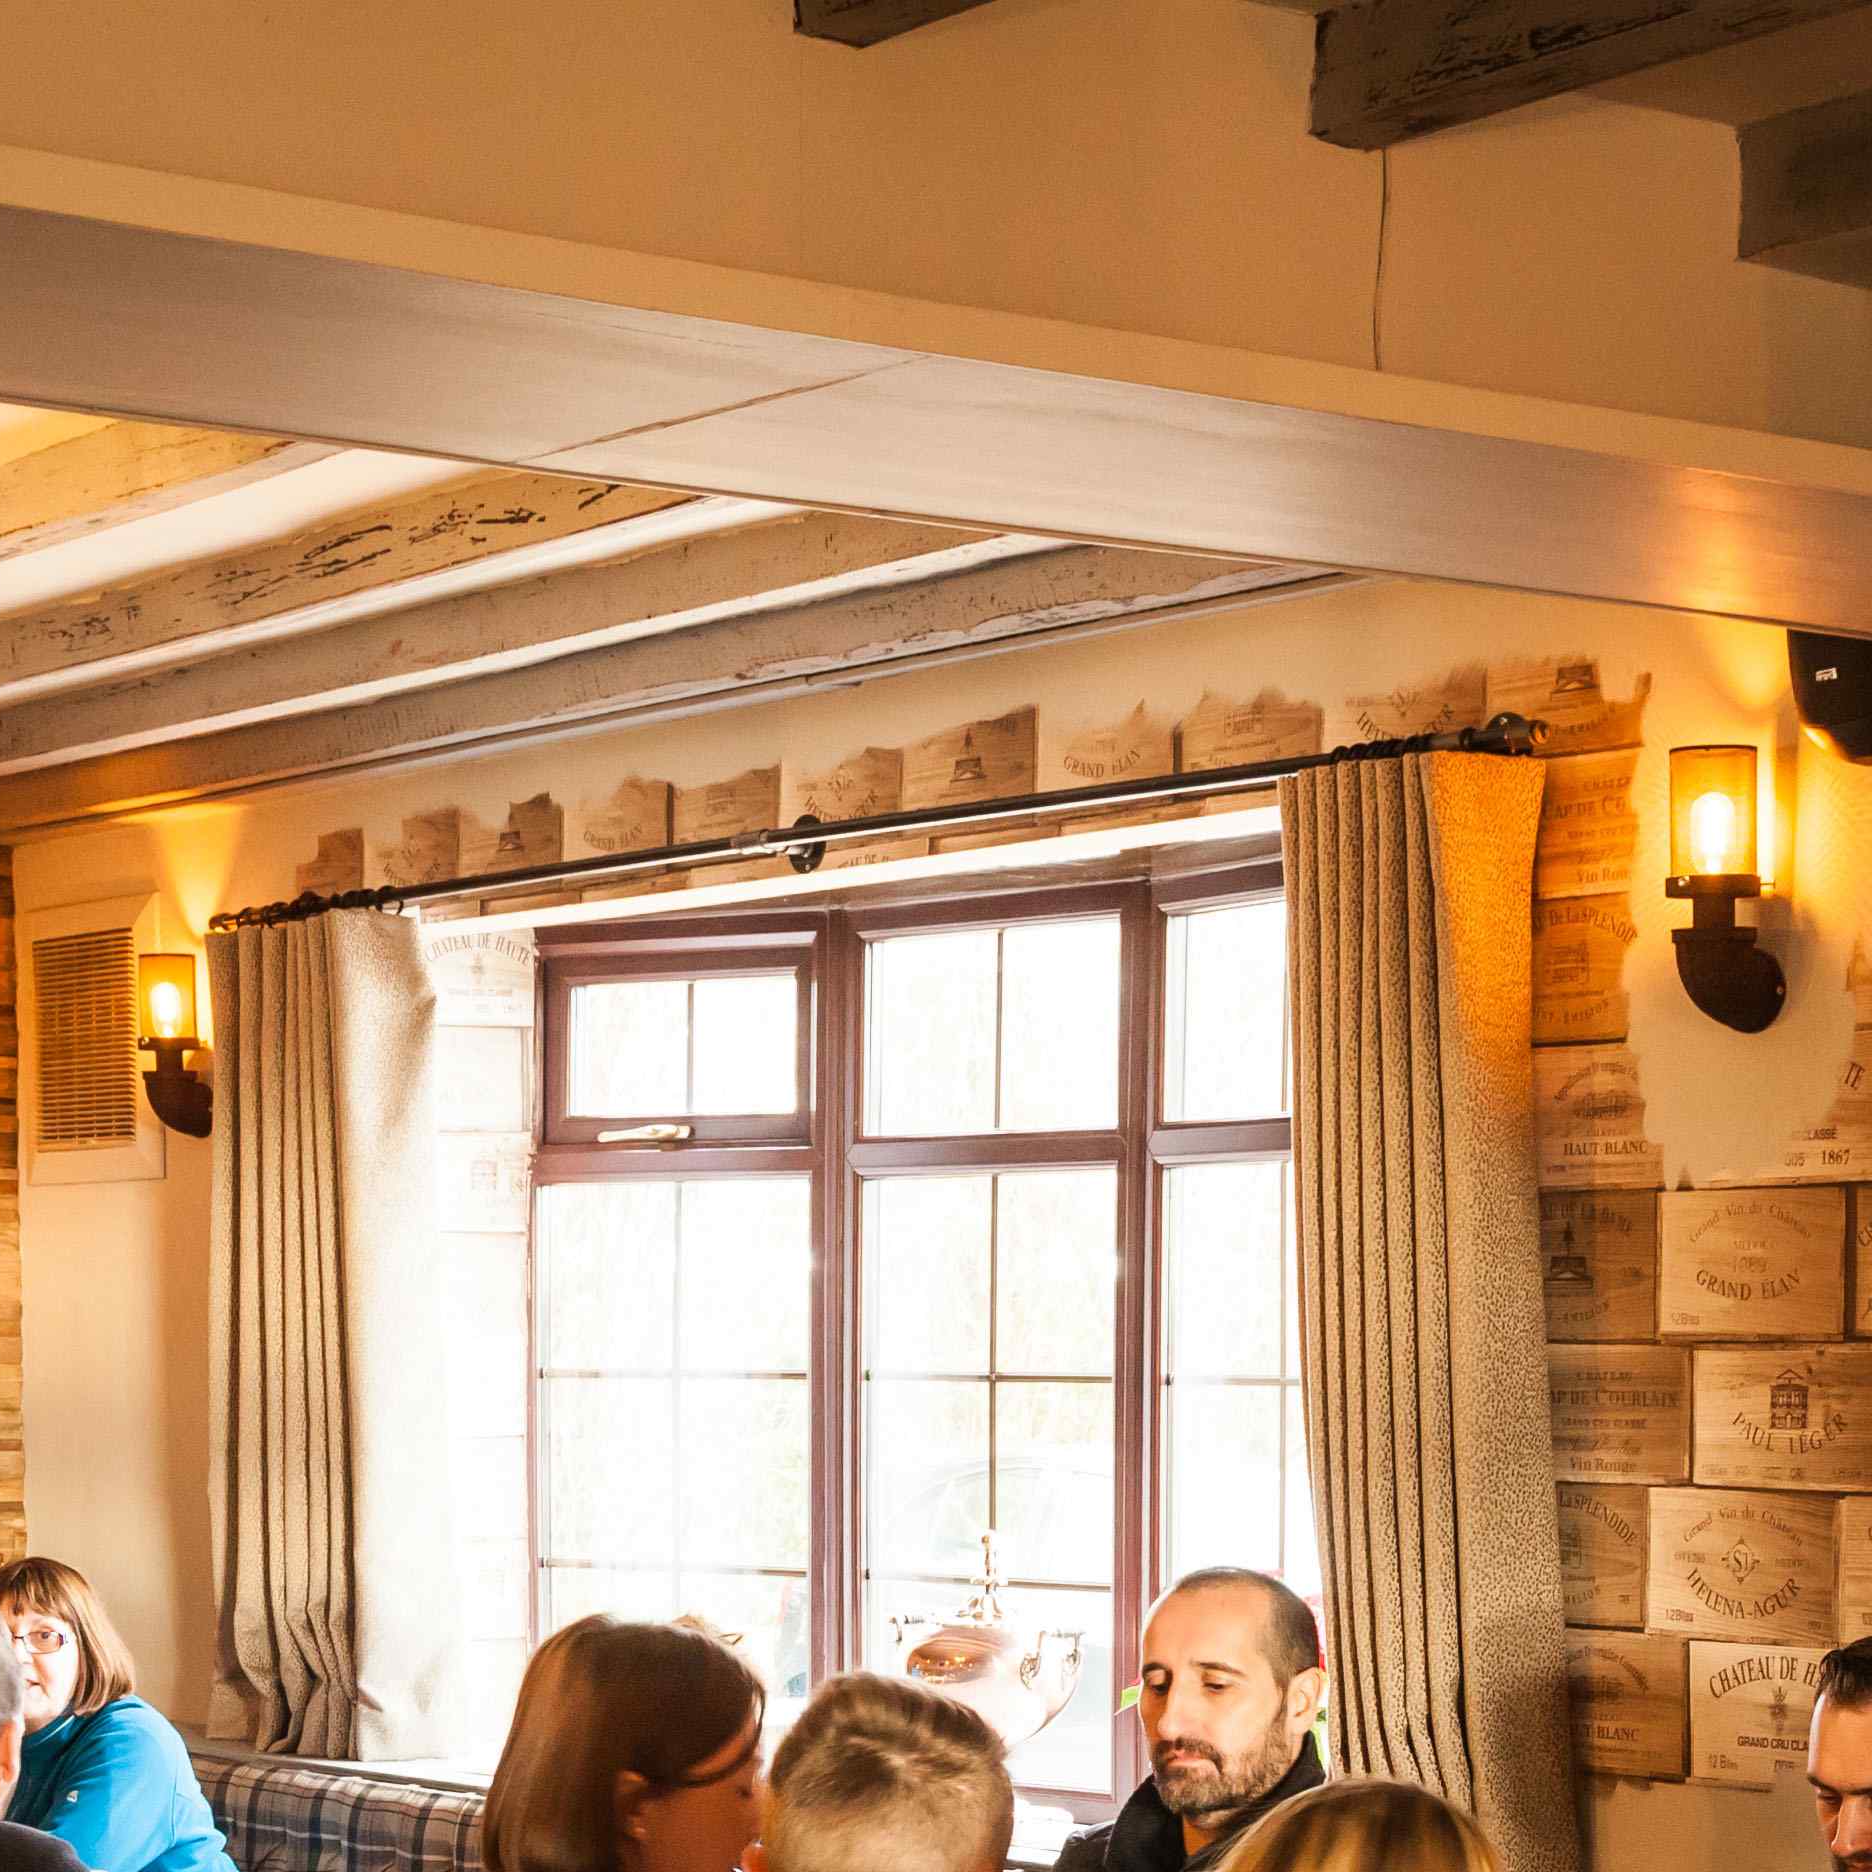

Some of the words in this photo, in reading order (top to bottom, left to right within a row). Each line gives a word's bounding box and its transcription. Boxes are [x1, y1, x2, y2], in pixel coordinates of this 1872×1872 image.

[1063, 755, 1104, 778] GRAND
[1821, 1149, 1850, 1166] 1867
[1695, 1268, 1751, 1301] GRAND
[1732, 1411, 1775, 1452] PAUL
[1570, 1456, 1592, 1472] Vin
[1595, 1457, 1638, 1476] Rouge
[1573, 1495, 1638, 1545] SPLENDIDE
[1683, 1511, 1714, 1543] Grand
[1719, 1507, 1737, 1520] Vin
[1687, 1566, 1802, 1620] HELENA-AGUR
[1709, 1656, 1774, 1700] CHATEAU
[1778, 1654, 1798, 1681] DE
[1736, 1735, 1769, 1749] GRAND
[1770, 1737, 1791, 1751] CRU
